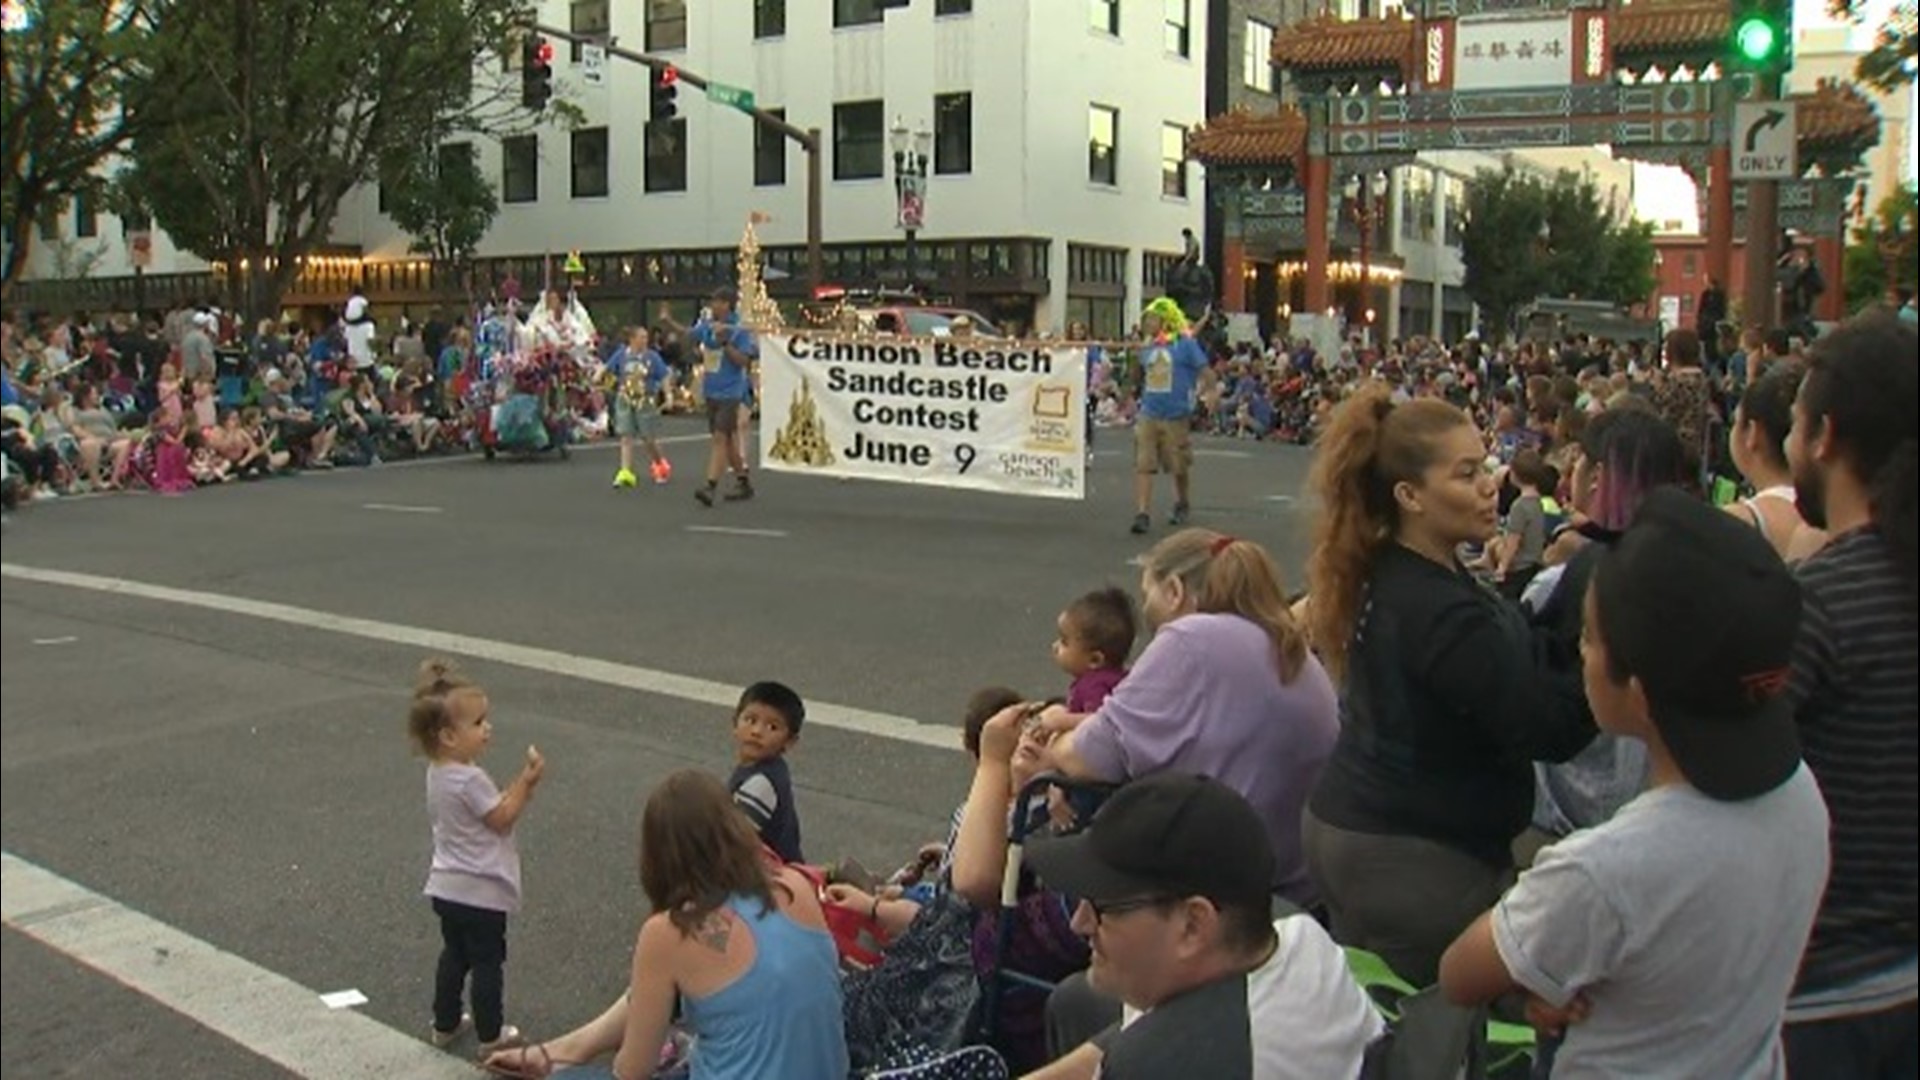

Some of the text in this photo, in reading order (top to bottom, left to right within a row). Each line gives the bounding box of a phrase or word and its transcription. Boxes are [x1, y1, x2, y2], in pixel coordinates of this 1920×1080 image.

[1740, 156, 1786, 171] ONLY
[786, 335, 1052, 374] Cannon Beach
[827, 367, 1008, 402] Sandcastle
[853, 399, 980, 432] Contest
[843, 433, 977, 475] June 9
